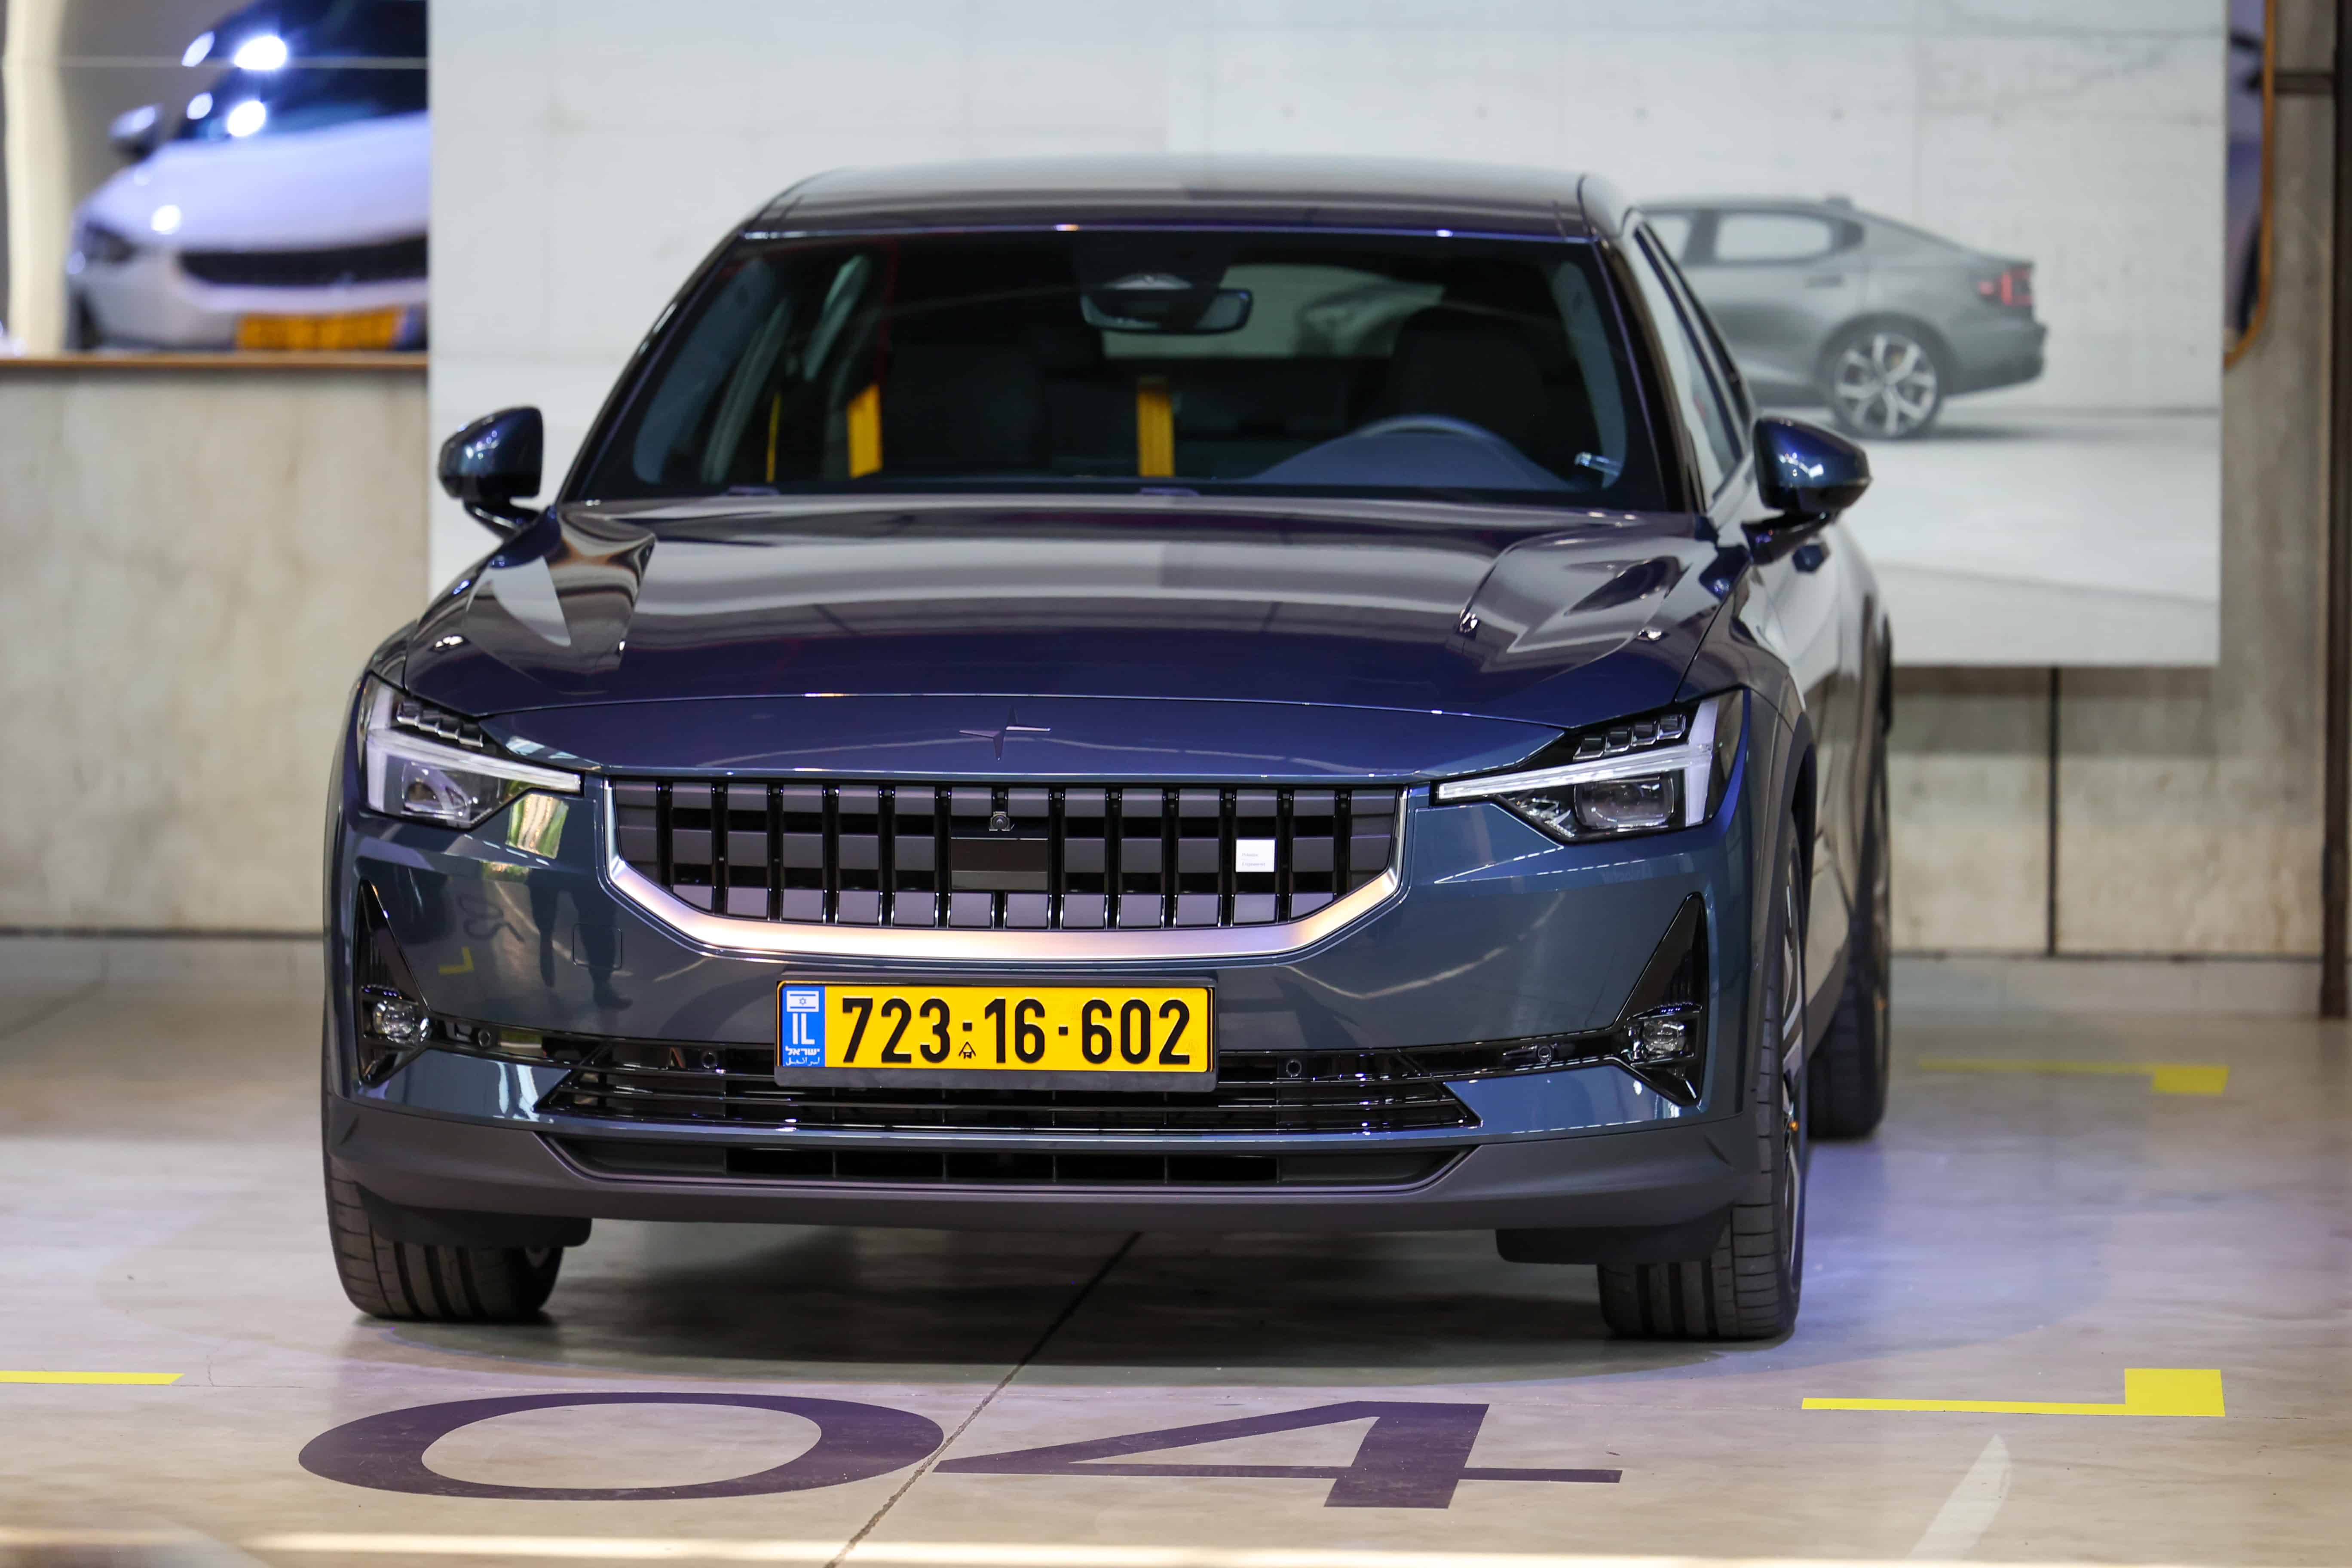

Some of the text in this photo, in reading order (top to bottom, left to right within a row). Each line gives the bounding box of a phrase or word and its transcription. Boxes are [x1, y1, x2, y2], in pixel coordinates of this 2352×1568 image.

[793, 1013, 815, 1045] IL
[785, 1045, 820, 1056] ישראל
[298, 1392, 1623, 1509] 04
